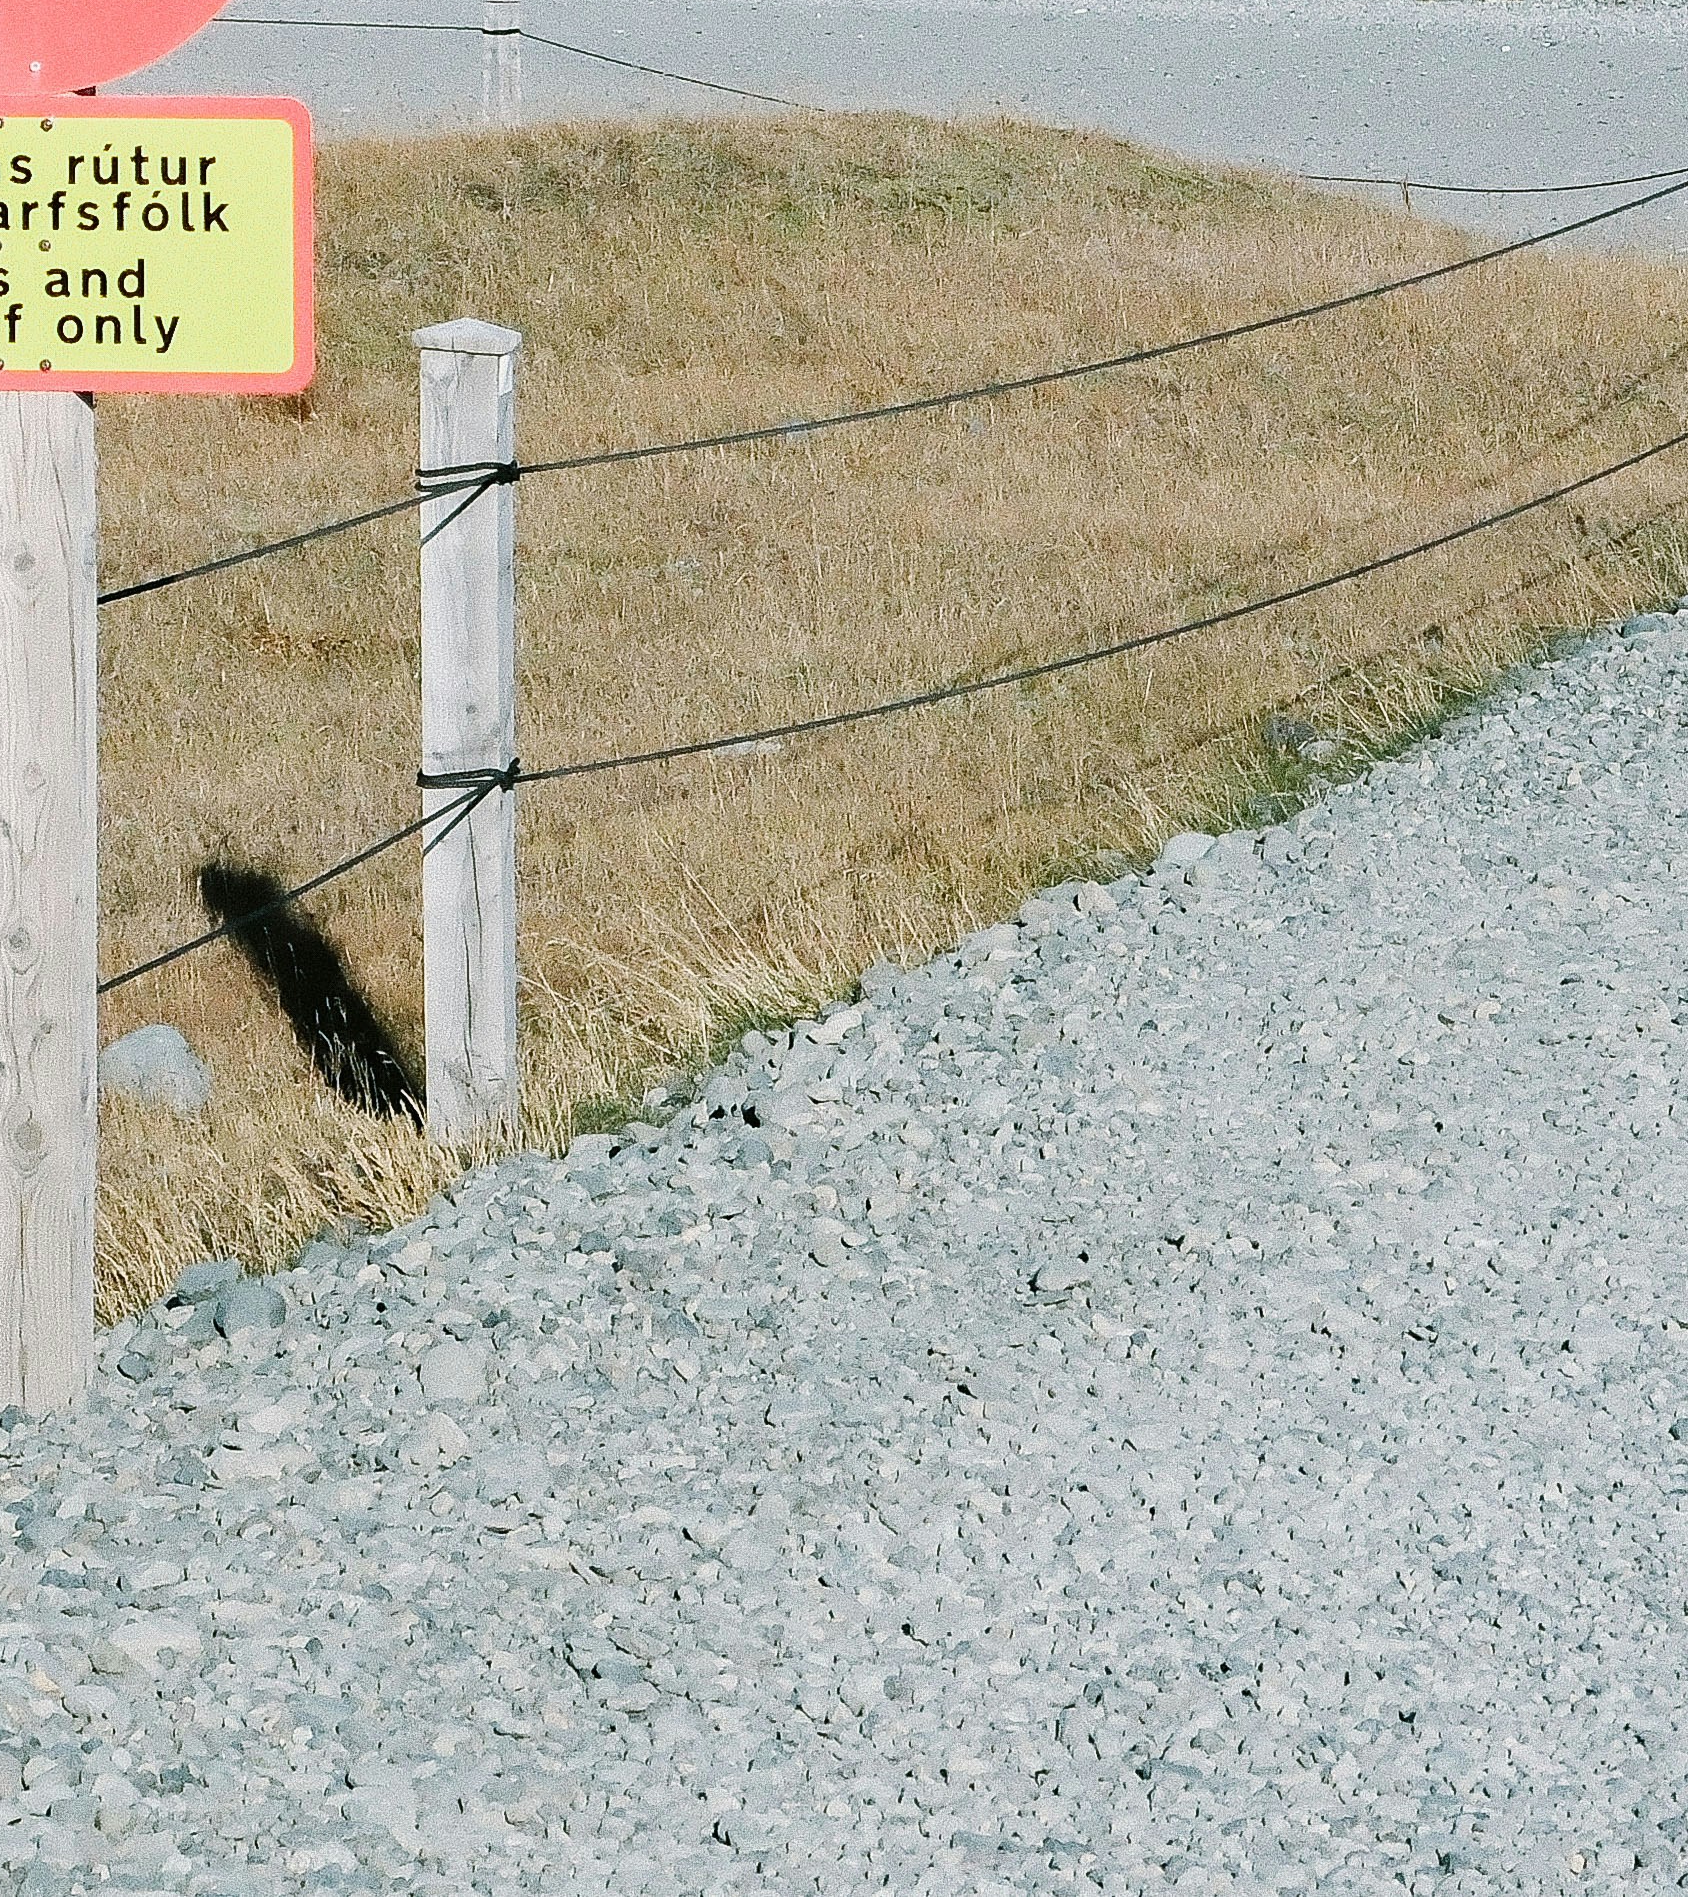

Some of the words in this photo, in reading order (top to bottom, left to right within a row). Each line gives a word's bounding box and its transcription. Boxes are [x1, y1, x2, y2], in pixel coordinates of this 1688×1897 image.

[68, 143, 216, 186] rútur
[44, 258, 145, 299] and
[56, 304, 180, 354] only
